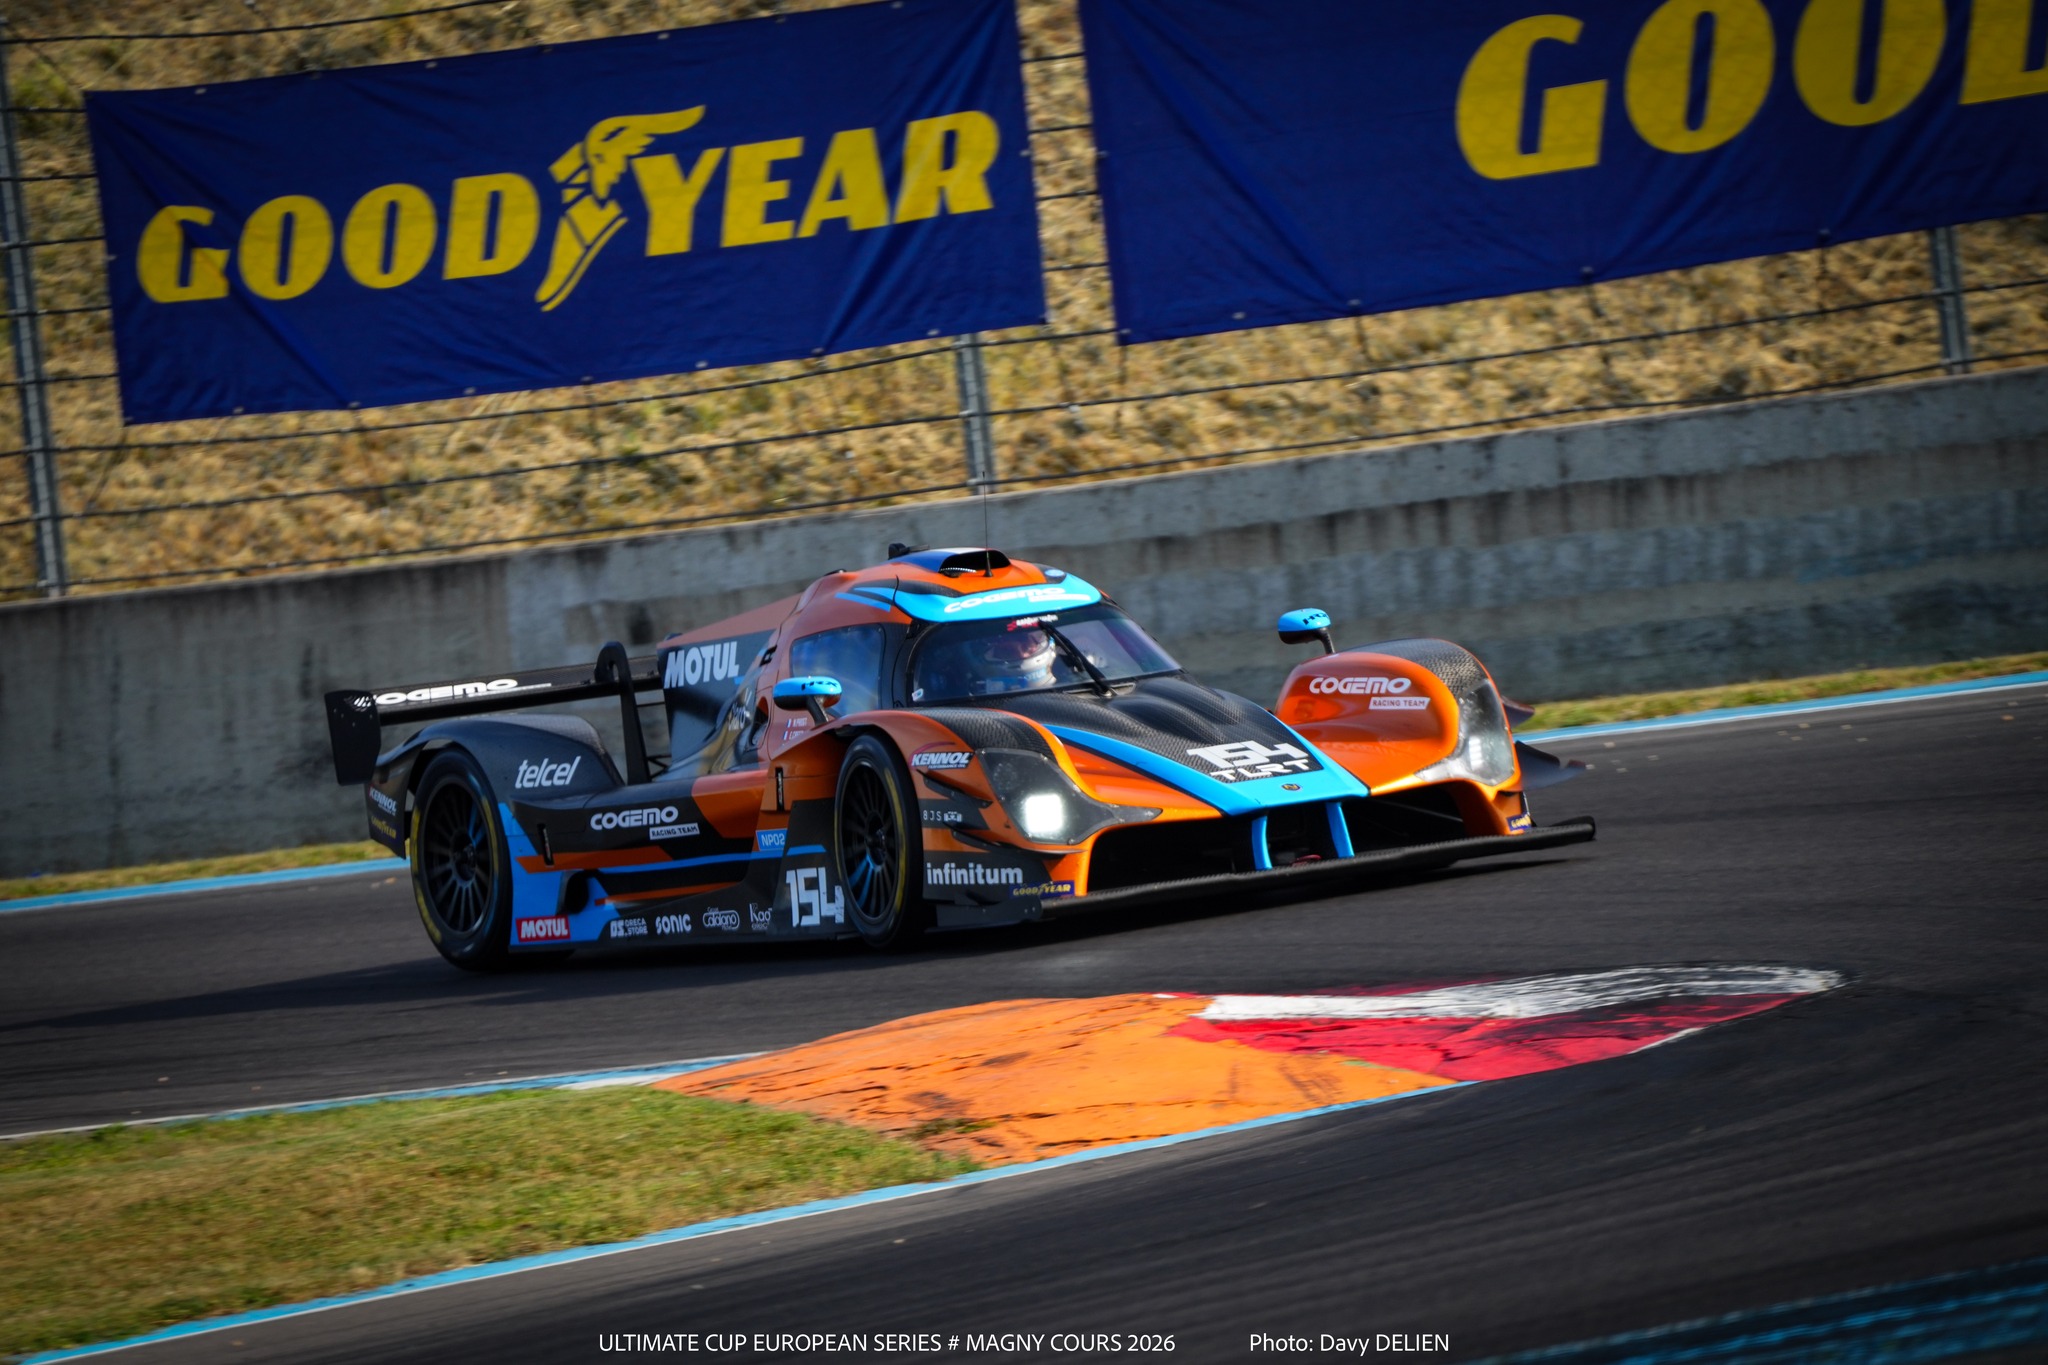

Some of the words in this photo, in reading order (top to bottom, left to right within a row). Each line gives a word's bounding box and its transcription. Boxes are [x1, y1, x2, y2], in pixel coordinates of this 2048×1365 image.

[664, 641, 739, 689] MOTUL
[1309, 677, 1411, 694] COGEMO
[1372, 698, 1400, 707] RACING
[1403, 698, 1426, 707] TEAM
[911, 751, 971, 766] KENNOL
[1186, 740, 1309, 769] 154
[514, 755, 582, 789] telcel
[369, 786, 397, 812] KENNOL
[590, 806, 679, 831] COGEMO
[651, 829, 677, 838] RACING
[678, 826, 698, 835] TEAM
[761, 833, 785, 847] NP02
[926, 862, 1024, 885] infinitum
[786, 866, 845, 928] 154
[521, 919, 569, 939] MOTUL
[624, 917, 646, 927] ORECA
[655, 913, 692, 935] SONIC
